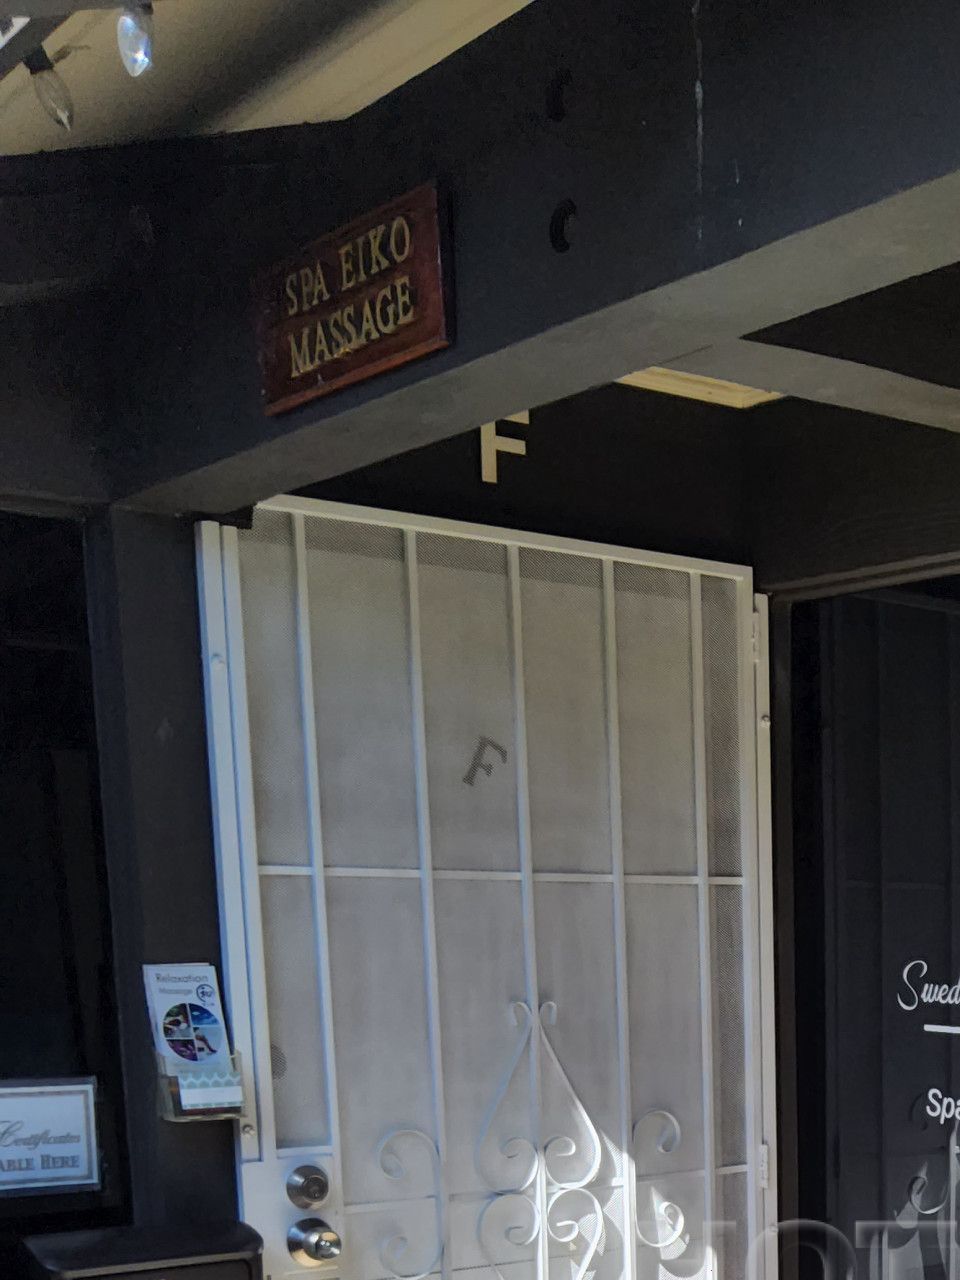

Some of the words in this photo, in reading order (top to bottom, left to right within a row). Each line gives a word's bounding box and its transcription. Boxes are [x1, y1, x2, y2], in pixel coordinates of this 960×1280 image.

[286, 261, 330, 316] SPA
[339, 216, 411, 290] EIKO
[287, 276, 415, 378] MASSAGE
[155, 973, 209, 984] Relaxation
